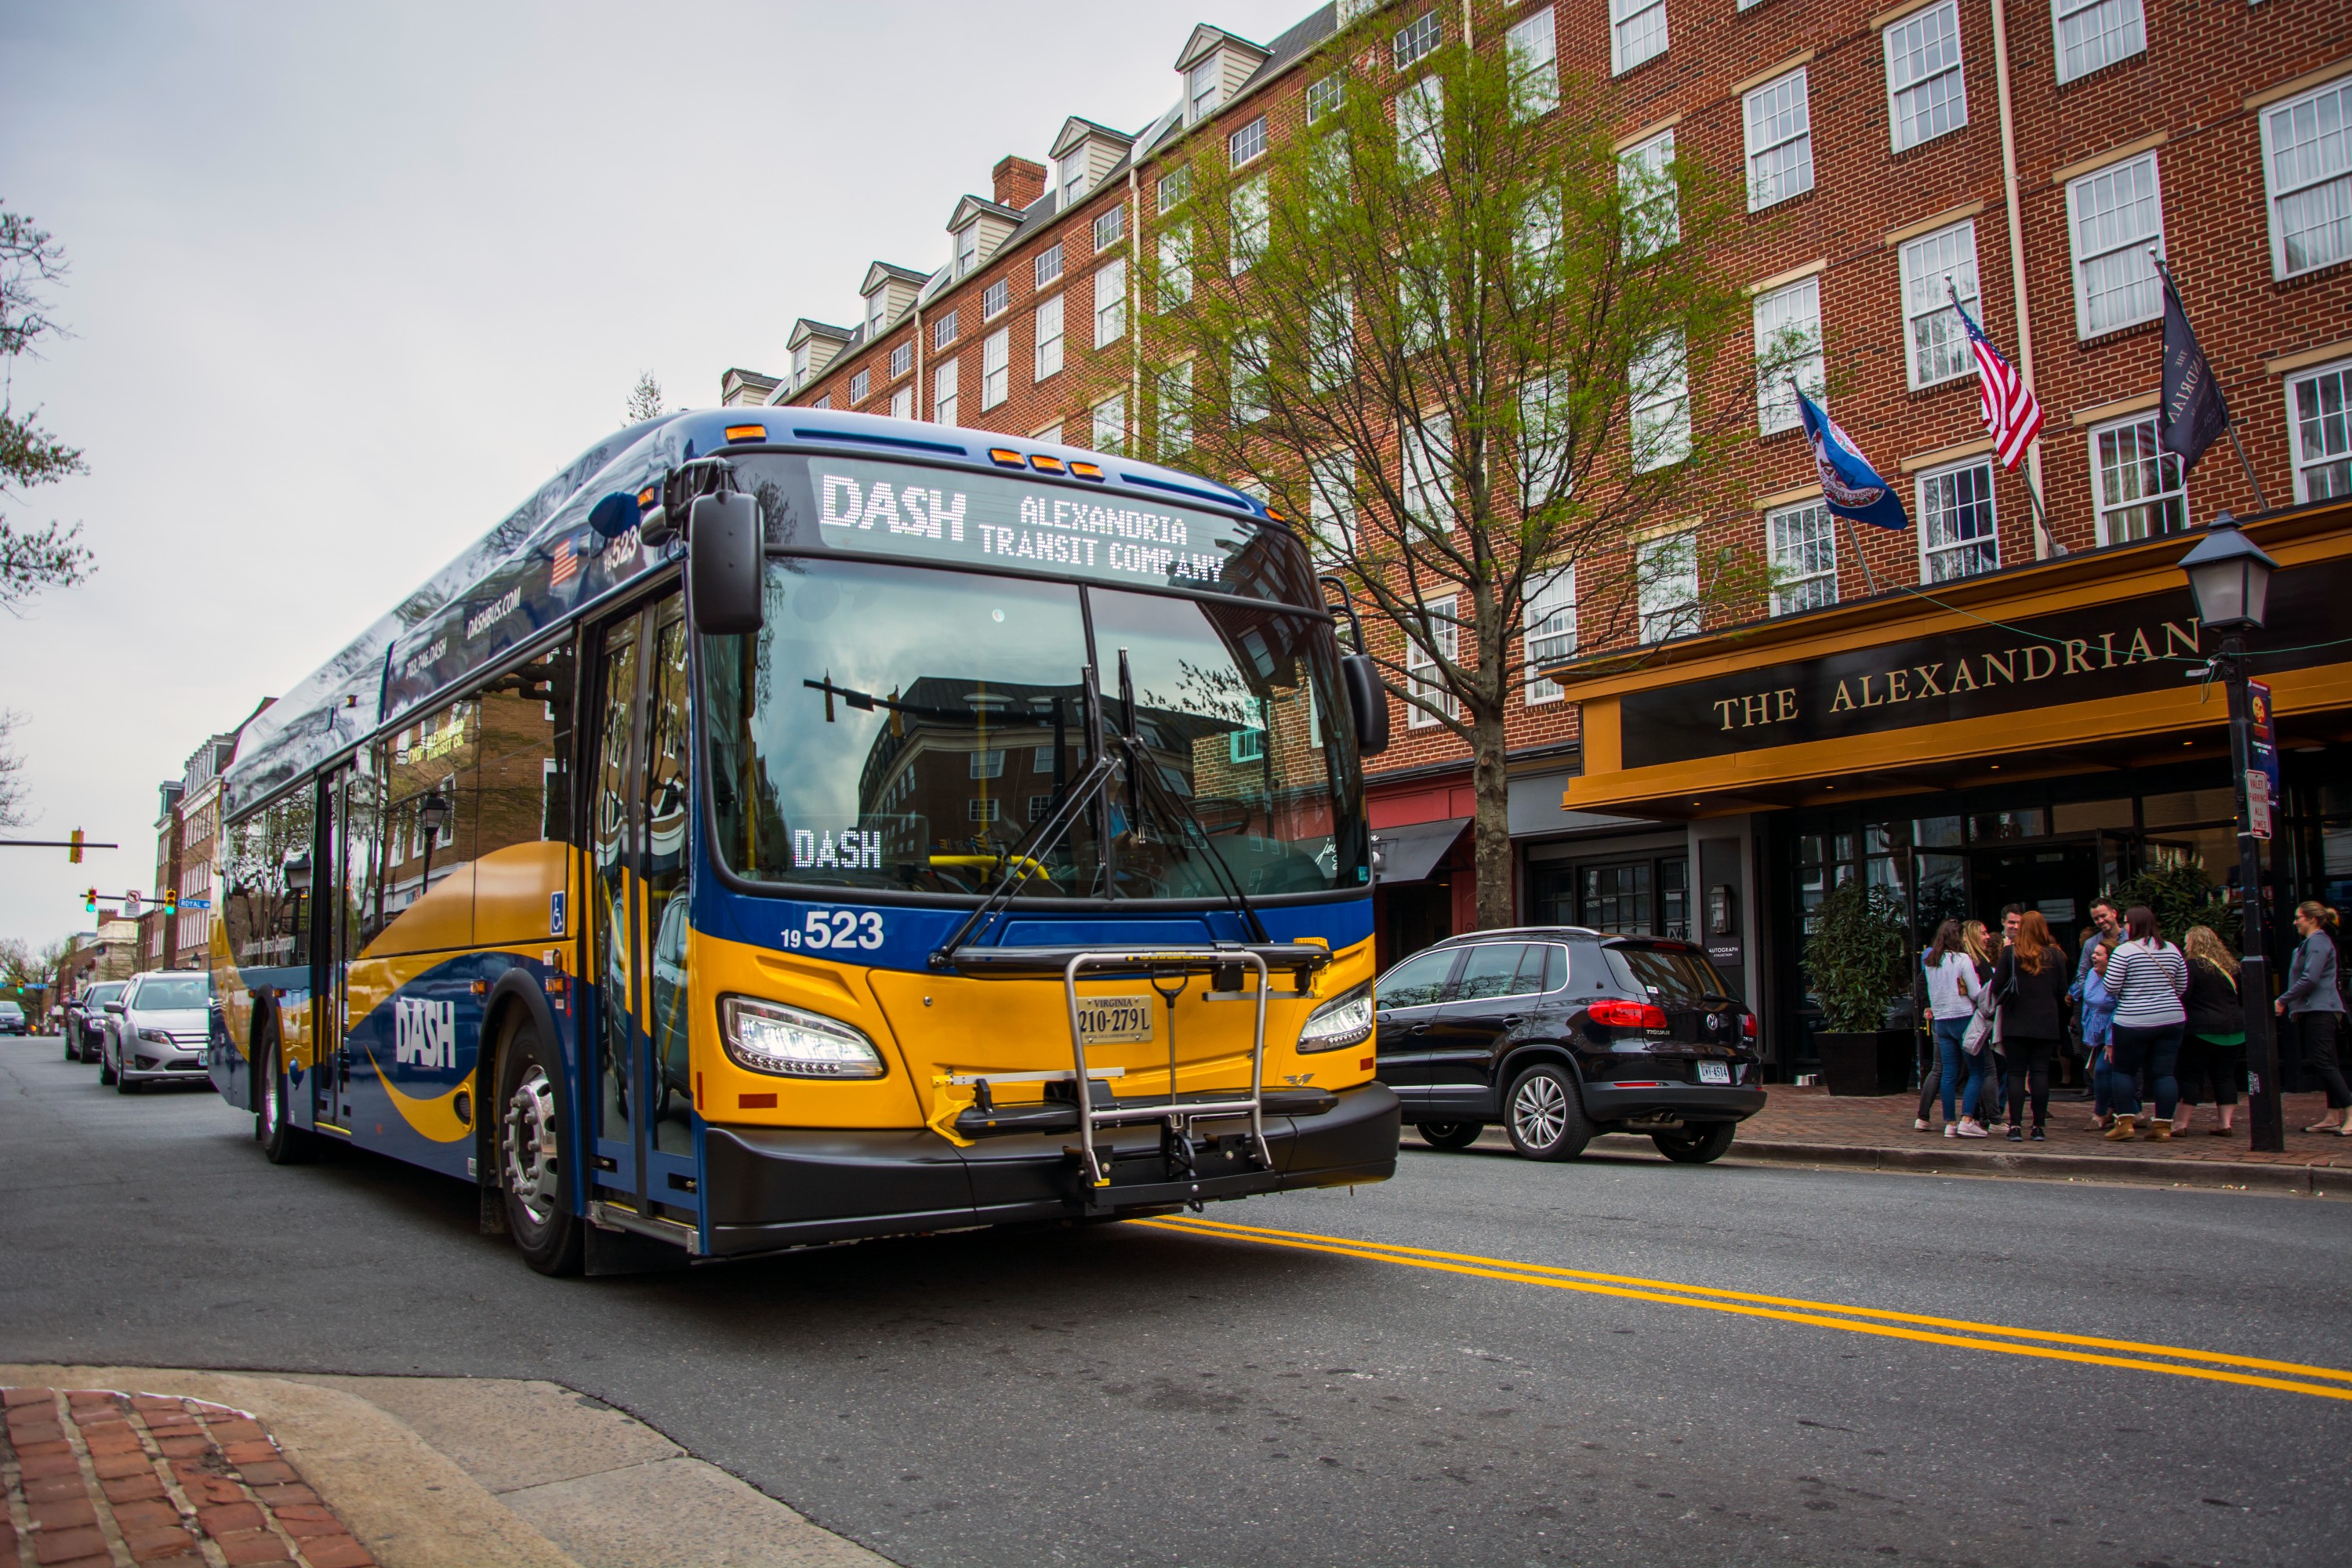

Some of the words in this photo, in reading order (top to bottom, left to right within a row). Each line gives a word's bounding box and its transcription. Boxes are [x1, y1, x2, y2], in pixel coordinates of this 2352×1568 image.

[820, 474, 966, 541] DASH
[1825, 481, 1845, 497] SEMPER
[1021, 495, 1187, 545] ALEXANDRIA
[604, 554, 612, 573] 19
[612, 524, 637, 568] 523
[978, 524, 1098, 566] TRANSIT
[1109, 543, 1224, 582] COMPANY
[467, 586, 521, 640] DASHBUS.COM
[1713, 688, 1798, 731] THE
[1829, 617, 2200, 713] ALEXANDRIAN
[2249, 792, 2267, 803] PARKING
[2250, 779, 2263, 789] VALET
[2253, 819, 2267, 829] TIMES
[2255, 807, 2263, 816] ALL
[795, 829, 880, 868] DASH
[180, 899, 201, 908] ROYAL
[780, 928, 800, 948] 19
[804, 911, 884, 949] 523
[1094, 998, 1133, 1007] VIRGINIA
[395, 1001, 456, 1069] DASH
